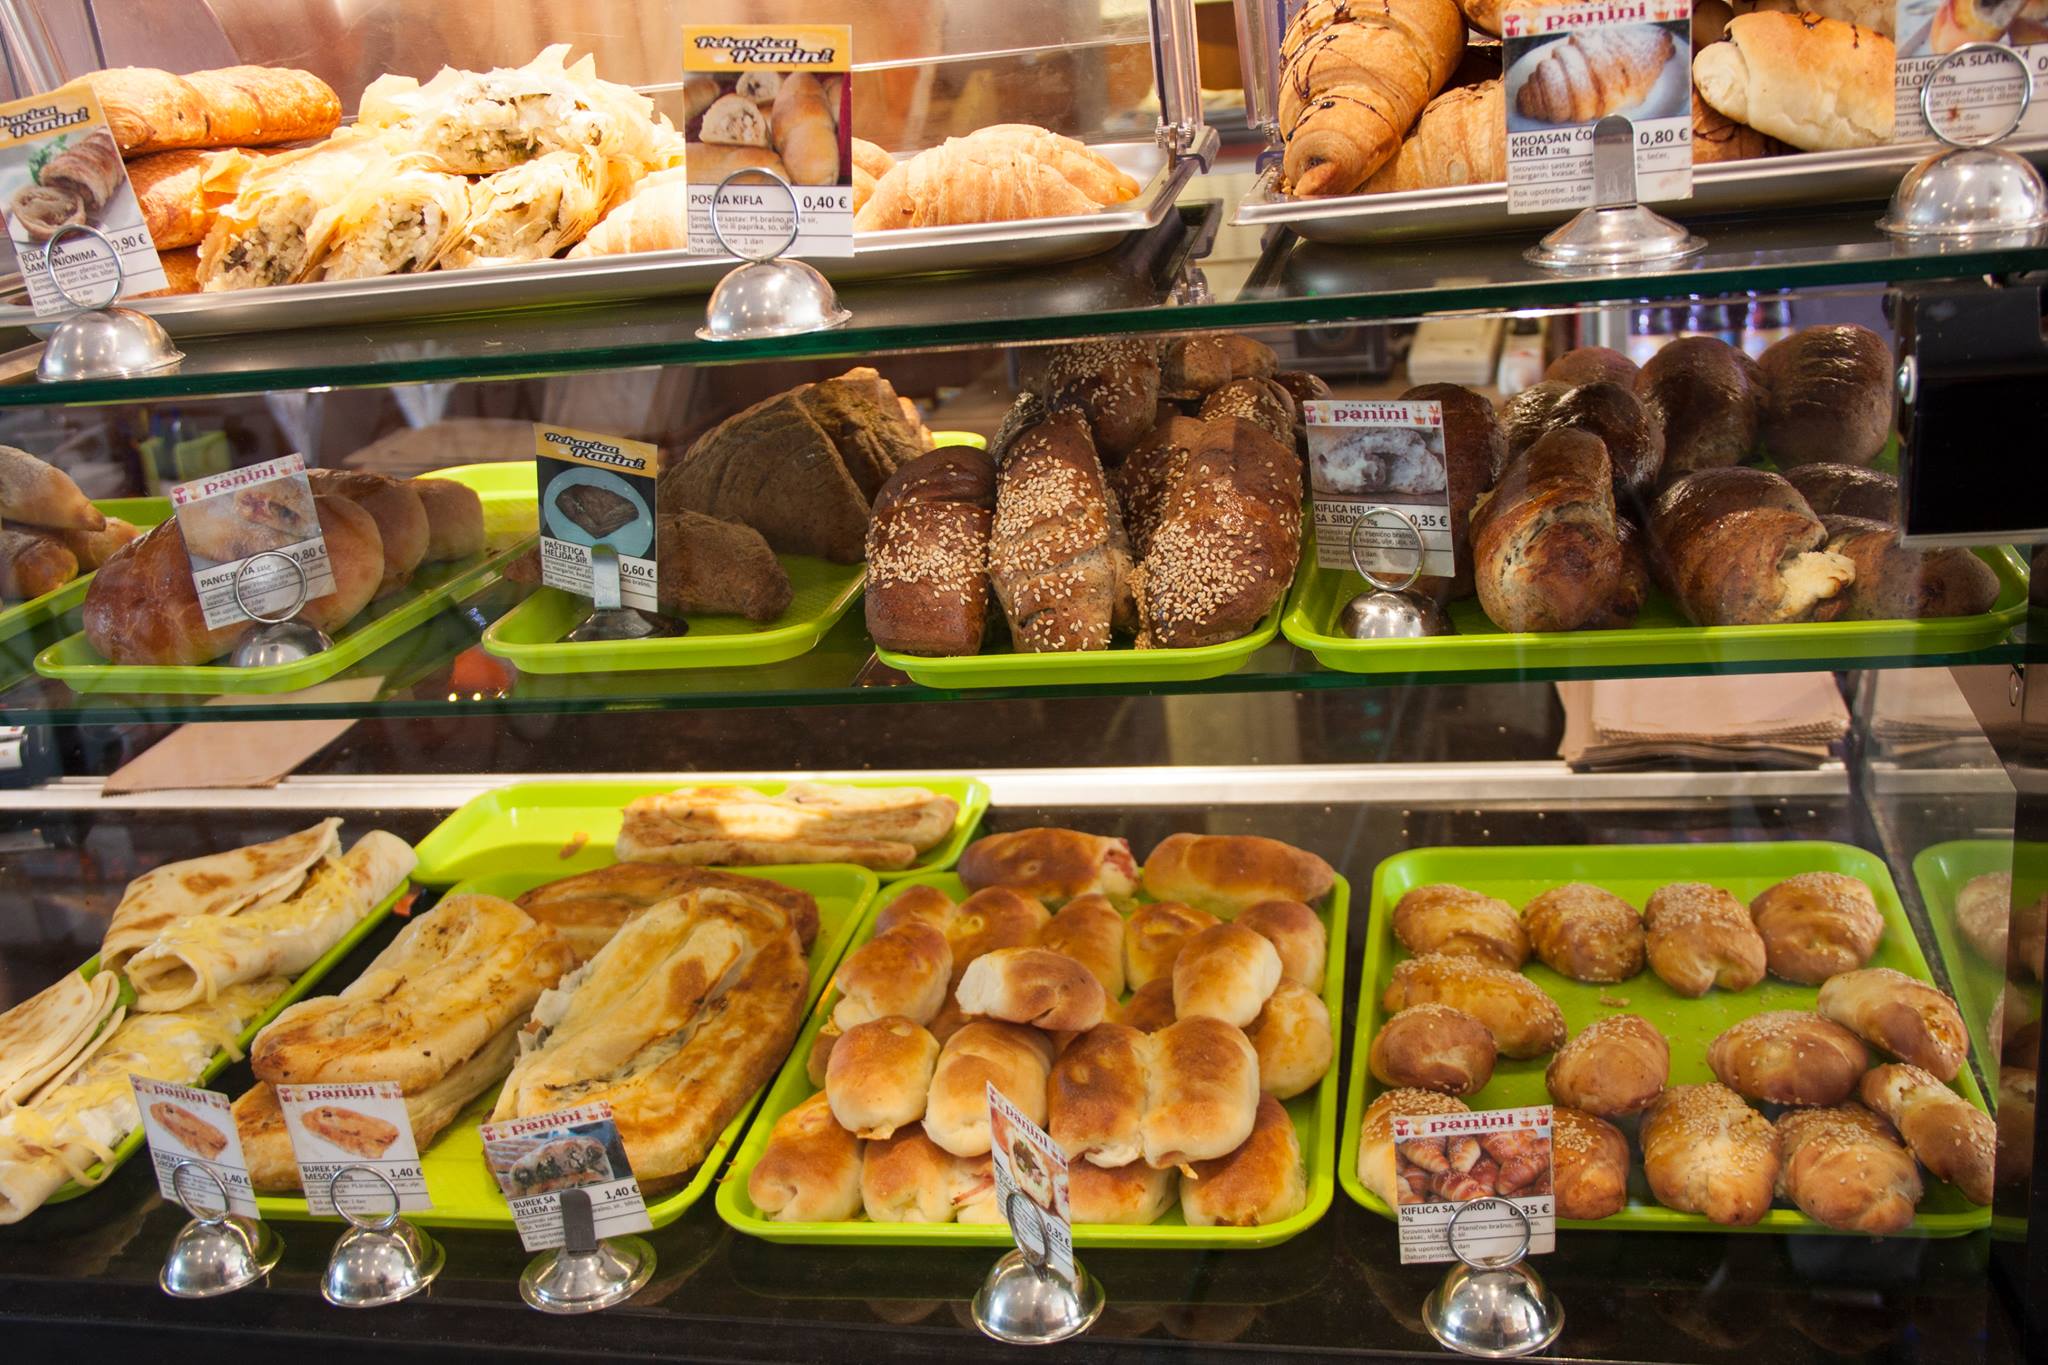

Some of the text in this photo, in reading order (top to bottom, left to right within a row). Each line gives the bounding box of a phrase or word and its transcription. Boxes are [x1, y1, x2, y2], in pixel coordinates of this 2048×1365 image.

[1546, 2, 1646, 31] panini
[695, 36, 797, 48] Pekarica
[730, 48, 835, 64] Panini
[1948, 56, 1966, 68] SA
[9, 107, 90, 138] Panini
[1511, 132, 1571, 147] KROASAN
[1640, 128, 1688, 147] 0,80 €
[1511, 146, 1548, 158] KREM
[732, 195, 764, 206] KIFLA
[803, 196, 848, 211] 0,40 €
[138, 233, 147, 245] €
[52, 246, 65, 256] SA
[1333, 407, 1409, 422] panini
[544, 432, 619, 454] Pekarica
[570, 446, 646, 470] Panini
[203, 464, 276, 495] panini
[1315, 503, 1348, 514] KIFLICA
[1315, 514, 1327, 523] SA
[1410, 514, 1448, 528] 0,35 €
[544, 540, 584, 556] PAŠTETICA
[544, 548, 587, 564] HELJDA-SIR
[622, 563, 655, 578] 0,60 €
[307, 1086, 376, 1100] panini
[511, 1110, 582, 1135] panini
[1430, 1113, 1514, 1133] panini
[302, 1165, 331, 1173] BUREK
[390, 1168, 414, 1178] 1,40
[605, 1184, 640, 1199] 1,40 €
[513, 1195, 556, 1209] BUREK SA
[1541, 1203, 1551, 1214] €
[517, 1204, 549, 1217] ZELJEM
[1401, 1205, 1442, 1215] KIFLICA
[1442, 1204, 1456, 1213] SA
[1401, 1215, 1414, 1223] 70g
